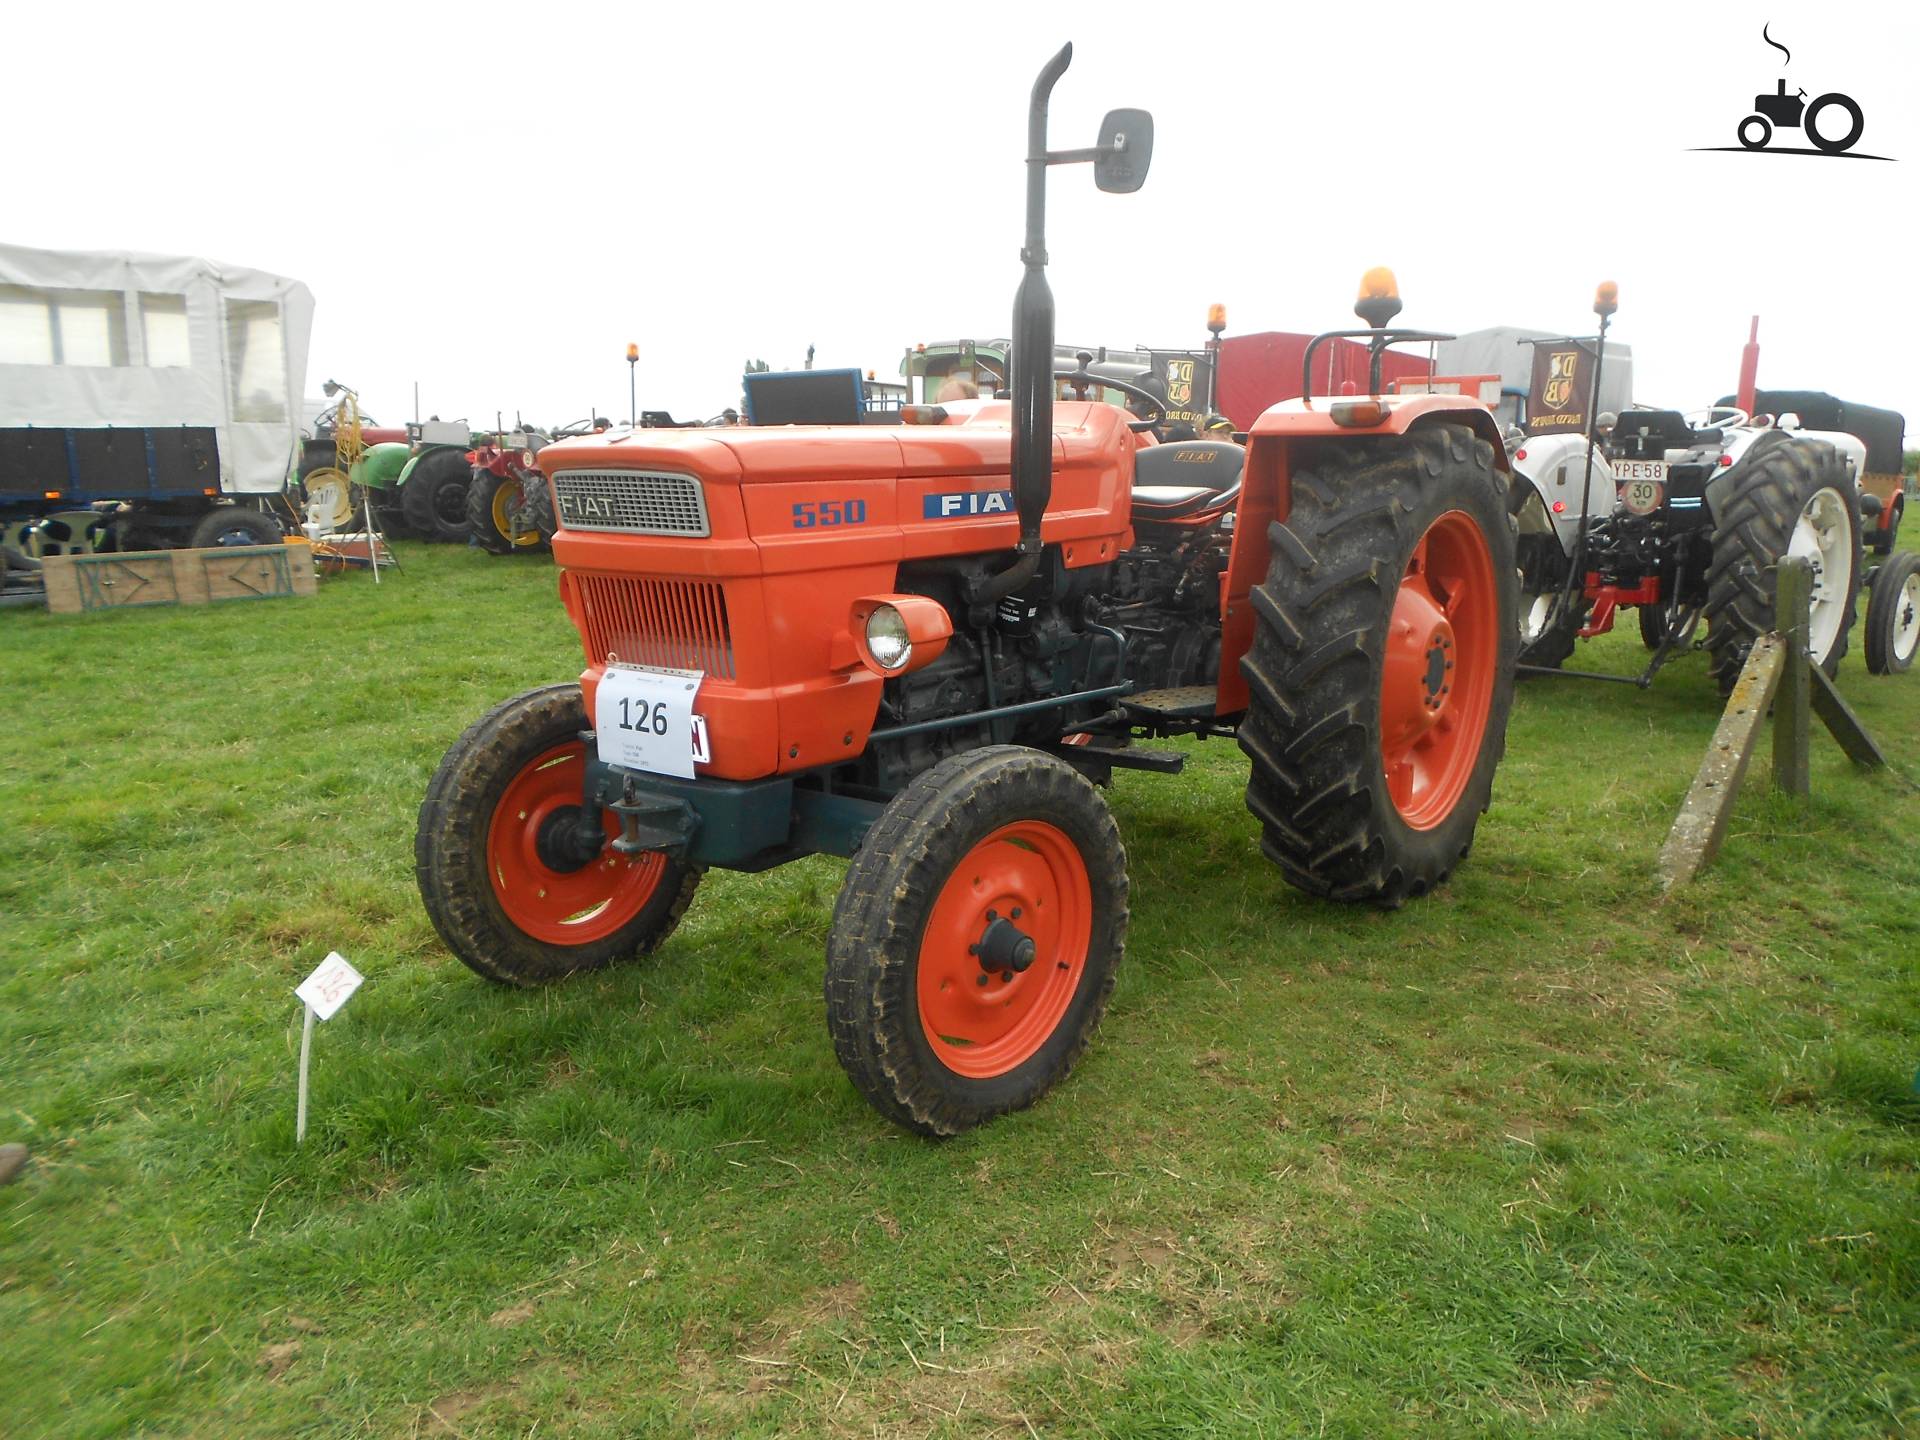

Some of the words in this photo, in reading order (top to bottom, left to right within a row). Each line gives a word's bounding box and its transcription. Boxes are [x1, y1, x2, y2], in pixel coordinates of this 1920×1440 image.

[1177, 452, 1215, 461] FIAT
[1633, 484, 1652, 499] 30
[560, 495, 613, 517] FIAT
[792, 499, 866, 529] 550
[941, 492, 1013, 516] FIA
[618, 696, 668, 736] 126
